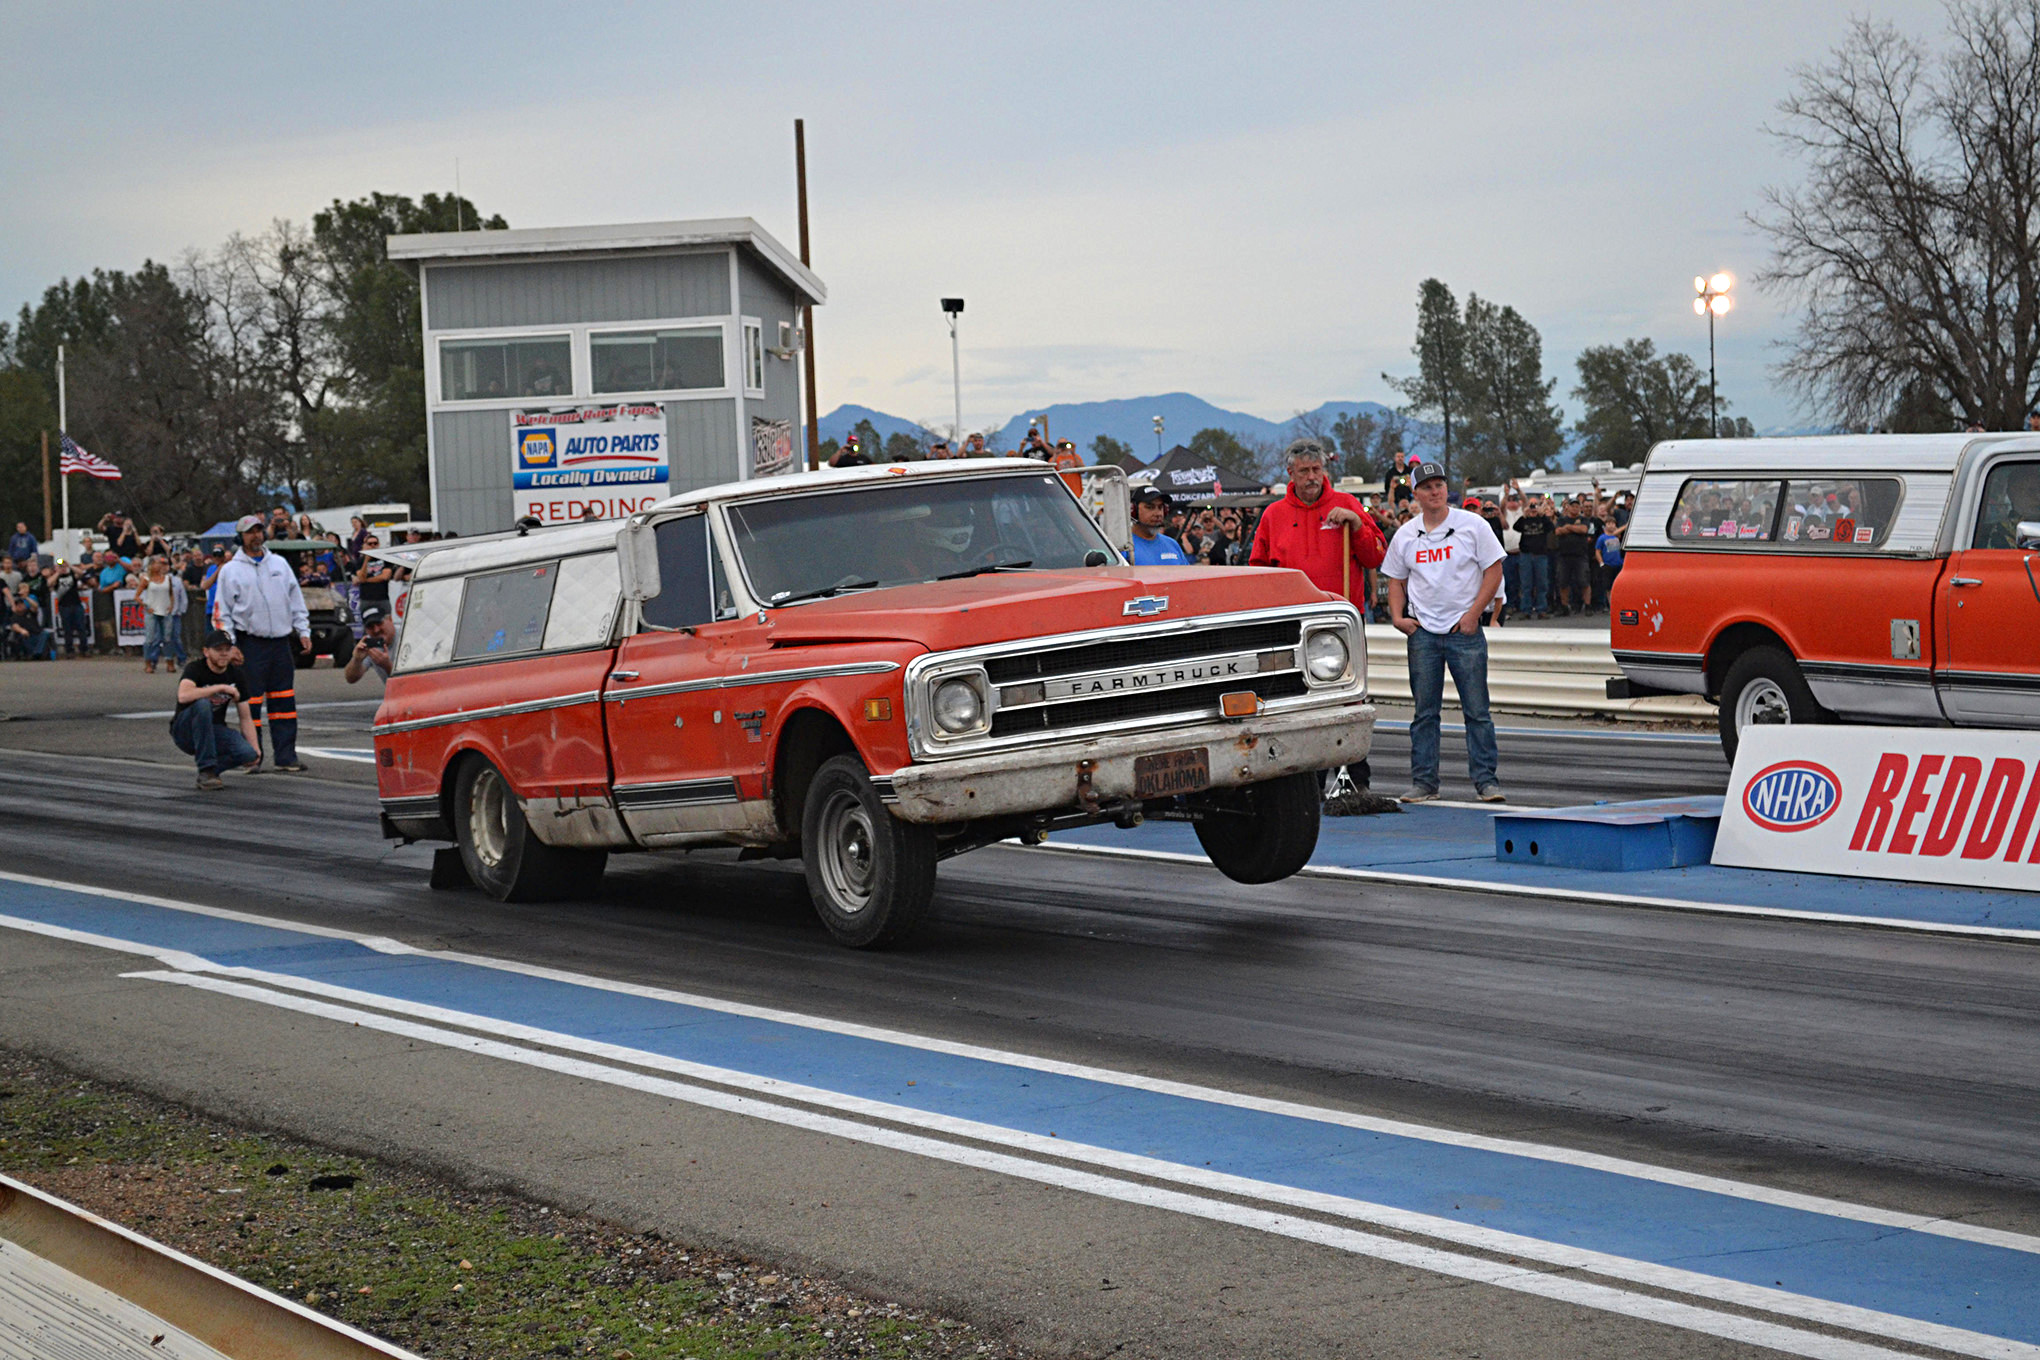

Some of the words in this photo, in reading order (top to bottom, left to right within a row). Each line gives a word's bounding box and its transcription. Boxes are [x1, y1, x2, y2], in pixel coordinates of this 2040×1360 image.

[516, 413, 581, 425] Welcome
[583, 406, 617, 420] Race
[526, 440, 549, 455] NAPA
[565, 435, 608, 455] AUTO
[611, 433, 660, 453] PARTS
[531, 470, 590, 486] Locally
[593, 467, 656, 483] Owned!
[1416, 545, 1454, 563] EMT
[1071, 662, 1239, 694] FARMTRUCK
[1139, 767, 1206, 794] OKLAHOMA
[1756, 771, 1826, 820] NHRA
[1847, 752, 2040, 864] REDDI
